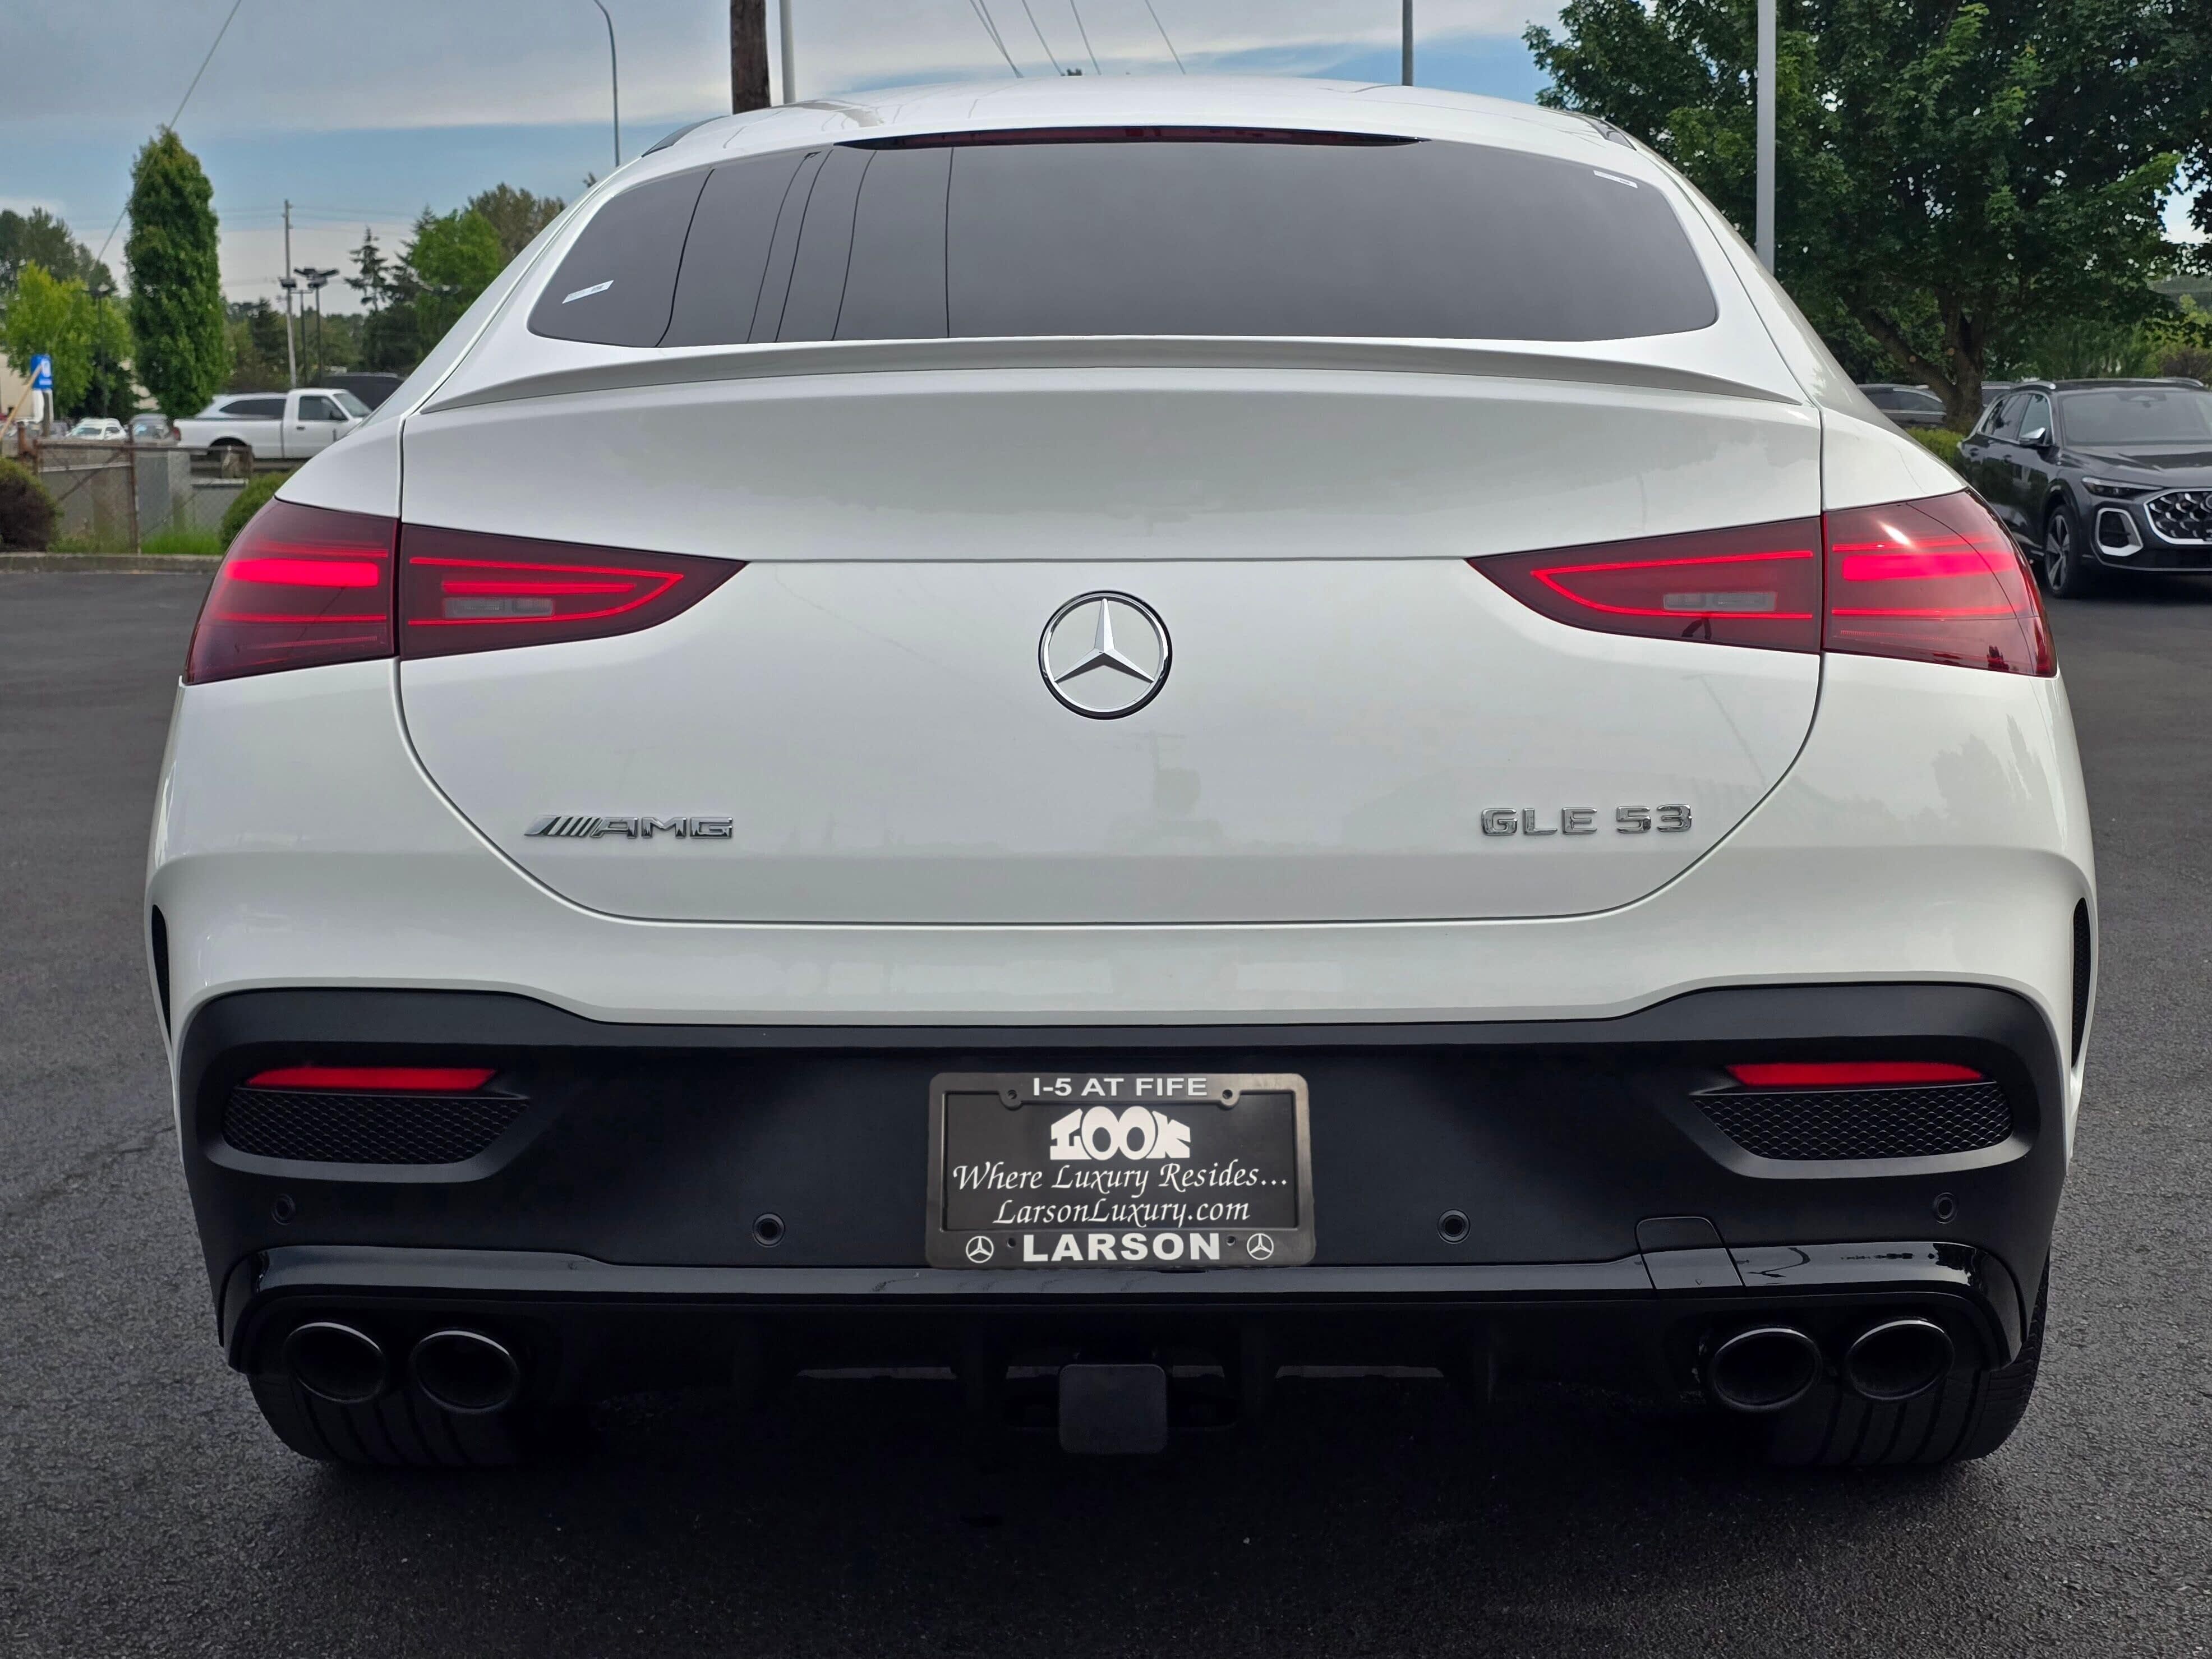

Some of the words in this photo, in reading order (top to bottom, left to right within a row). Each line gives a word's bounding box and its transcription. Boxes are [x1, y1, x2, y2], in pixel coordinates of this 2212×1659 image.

[589, 816, 734, 839] AMG
[1481, 807, 1598, 836] GLE
[1616, 803, 1692, 833] 53
[1034, 1077, 1072, 1096] I-5
[1081, 1077, 1125, 1096] AT
[1136, 1077, 1208, 1096] FIFE
[1050, 1105, 1191, 1160] LOOK
[953, 1161, 1043, 1190] Where
[1050, 1164, 1149, 1199] Luxury
[1158, 1159, 1287, 1193] Resides...
[992, 1197, 1251, 1229] LarsonLuxury.com
[1023, 1232, 1220, 1262] LARSON
